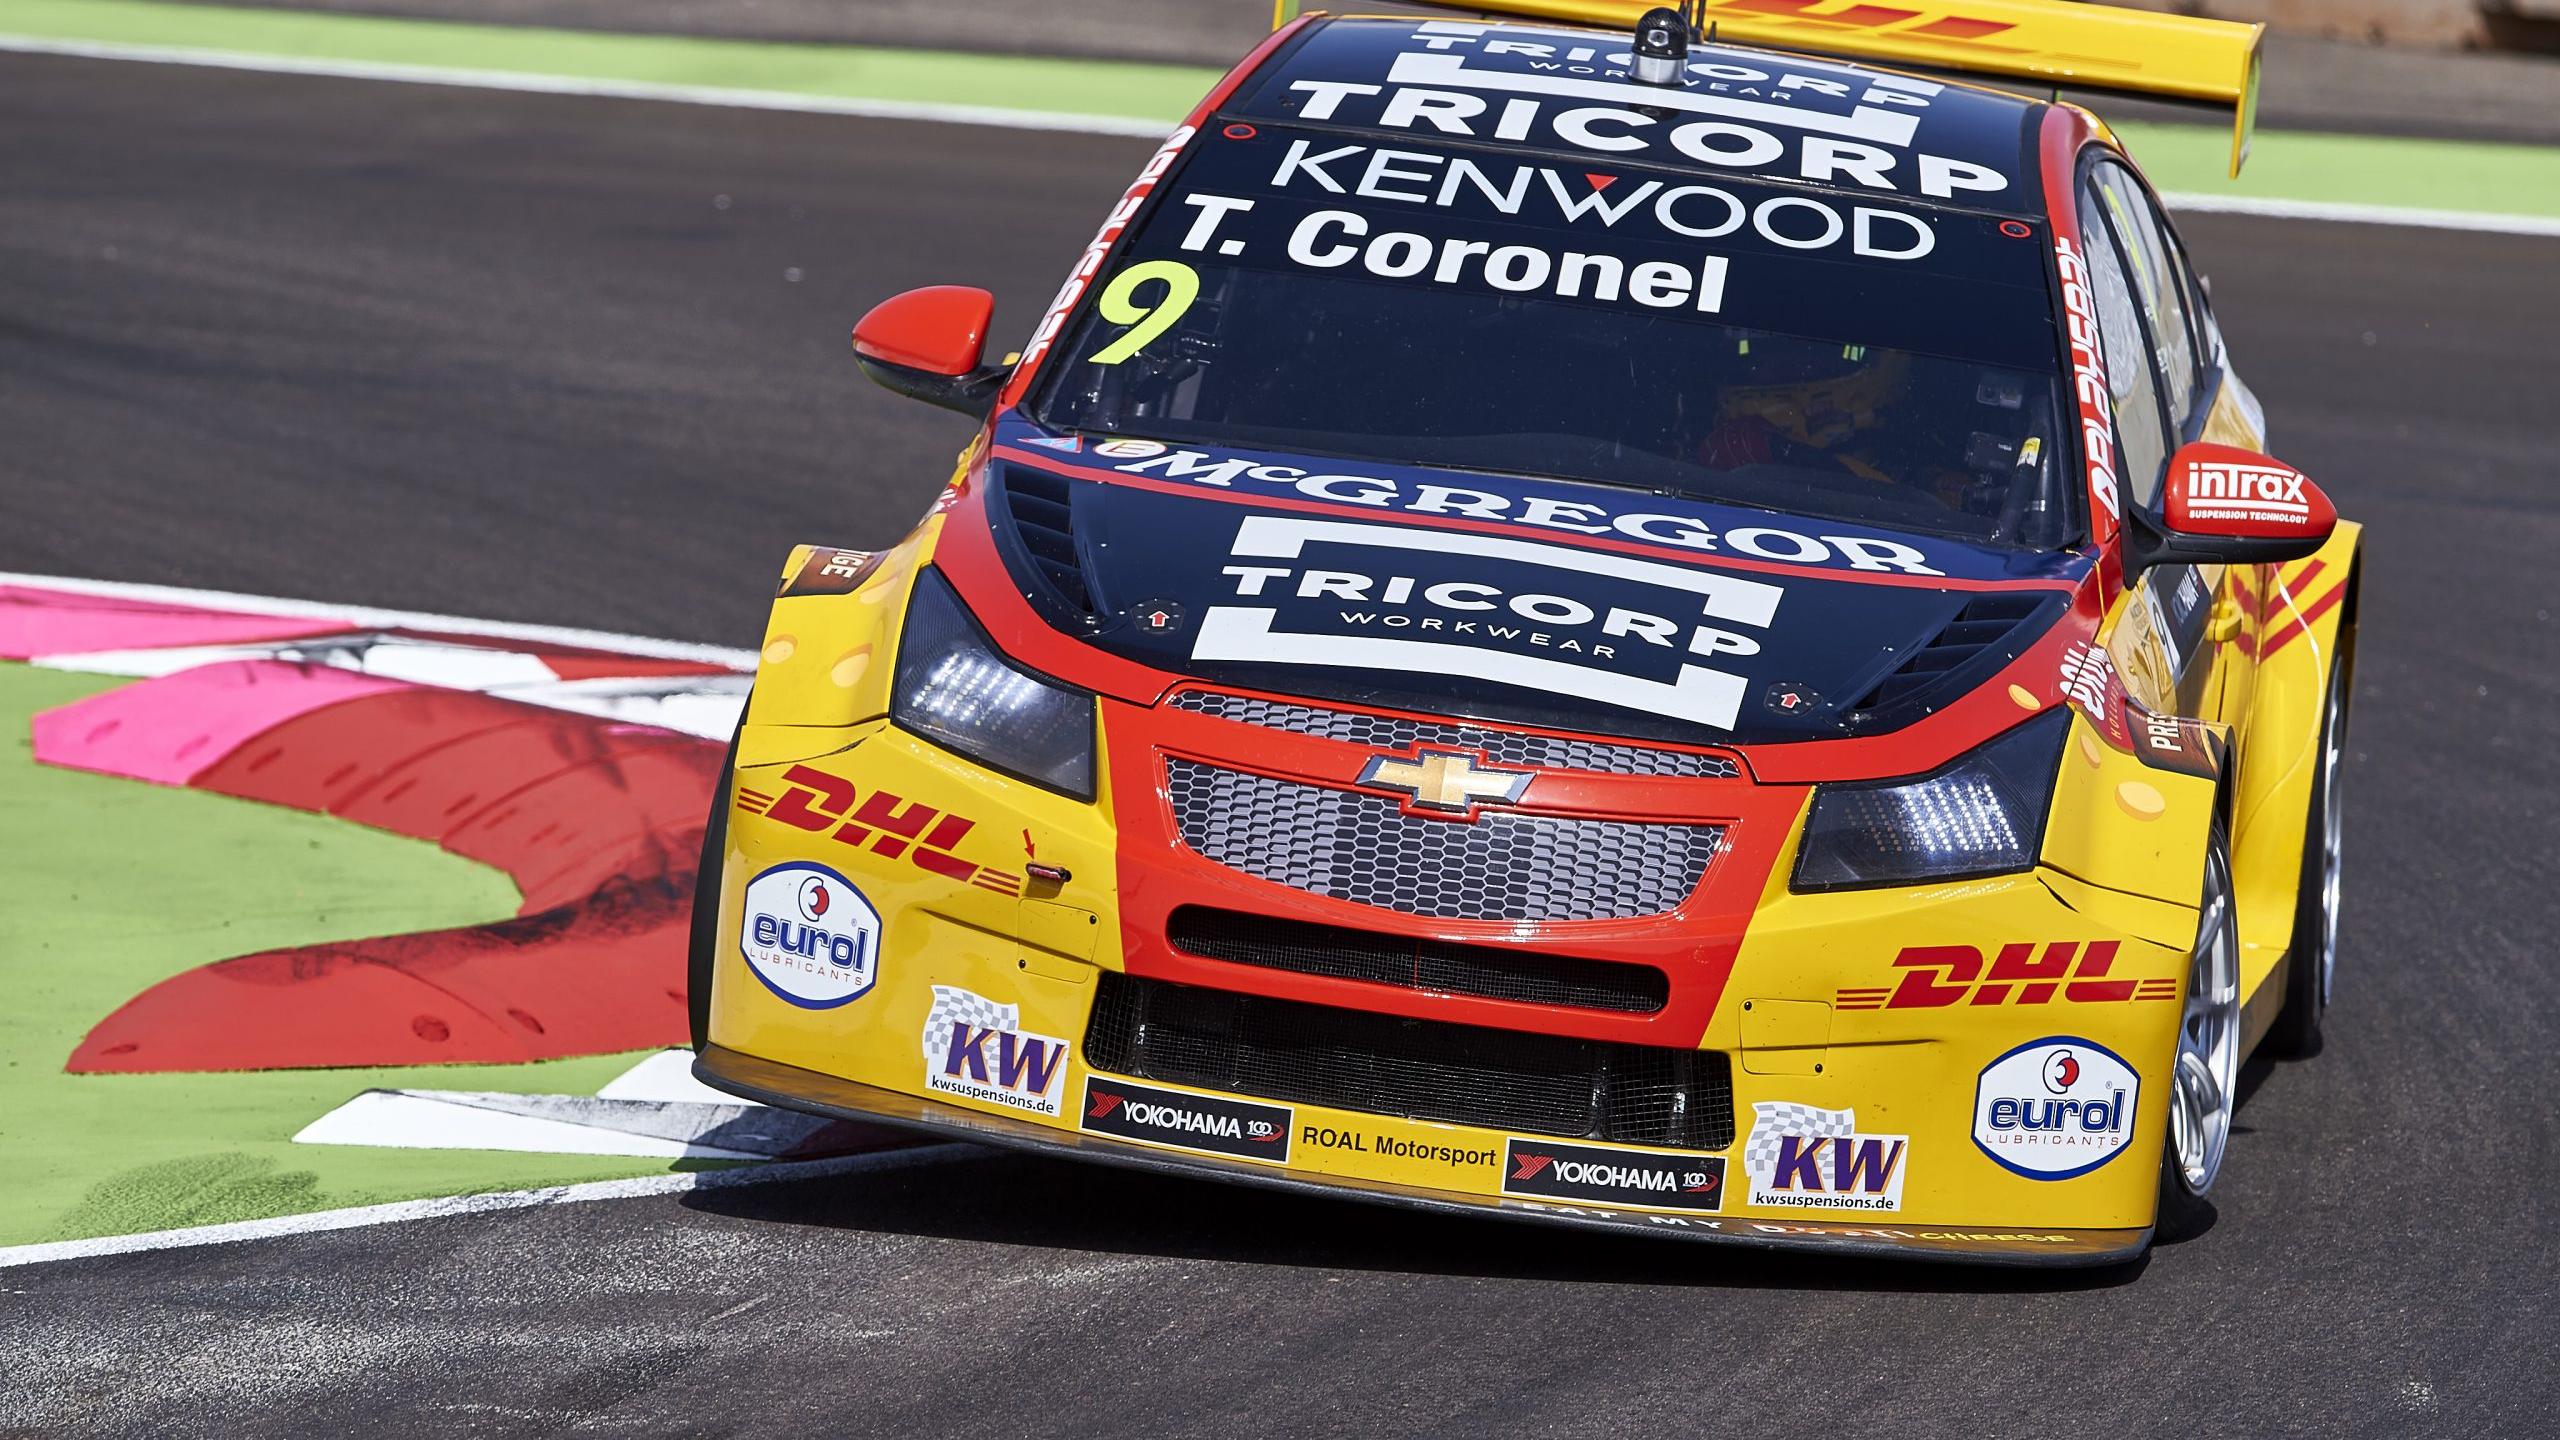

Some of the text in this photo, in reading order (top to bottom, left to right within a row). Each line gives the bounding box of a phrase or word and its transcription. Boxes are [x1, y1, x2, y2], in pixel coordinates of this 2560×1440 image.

[1288, 79, 2009, 199] TRICORP
[1271, 139, 1936, 261] KENWOOD
[1180, 193, 1729, 314] T. Coronel
[1088, 260, 1200, 365] 9
[2189, 509, 2308, 525] SUSPENSION TECHNOLOGY
[1222, 566, 1761, 659] TRICORP
[1341, 611, 1616, 659] WORKWEAR
[764, 763, 980, 883] DHL
[749, 946, 864, 986] LUBRICANTS
[752, 913, 868, 972] eurol
[1885, 940, 2139, 1009] DHL
[944, 1022, 1068, 1098] KW
[931, 1075, 1055, 1114] kwsuspensions.de
[1988, 1088, 2126, 1134] eurol
[1123, 1099, 1242, 1140] YOKOHAMA
[1985, 1133, 2120, 1148] LUBRICANTS
[1303, 1126, 1496, 1168] ROAL Motorsport
[1772, 1136, 1906, 1194] KW
[1553, 1160, 1678, 1193] YOKOHAMA
[1755, 1191, 1894, 1210] kwsuspensions.de
[1649, 1216, 1722, 1229] MY
